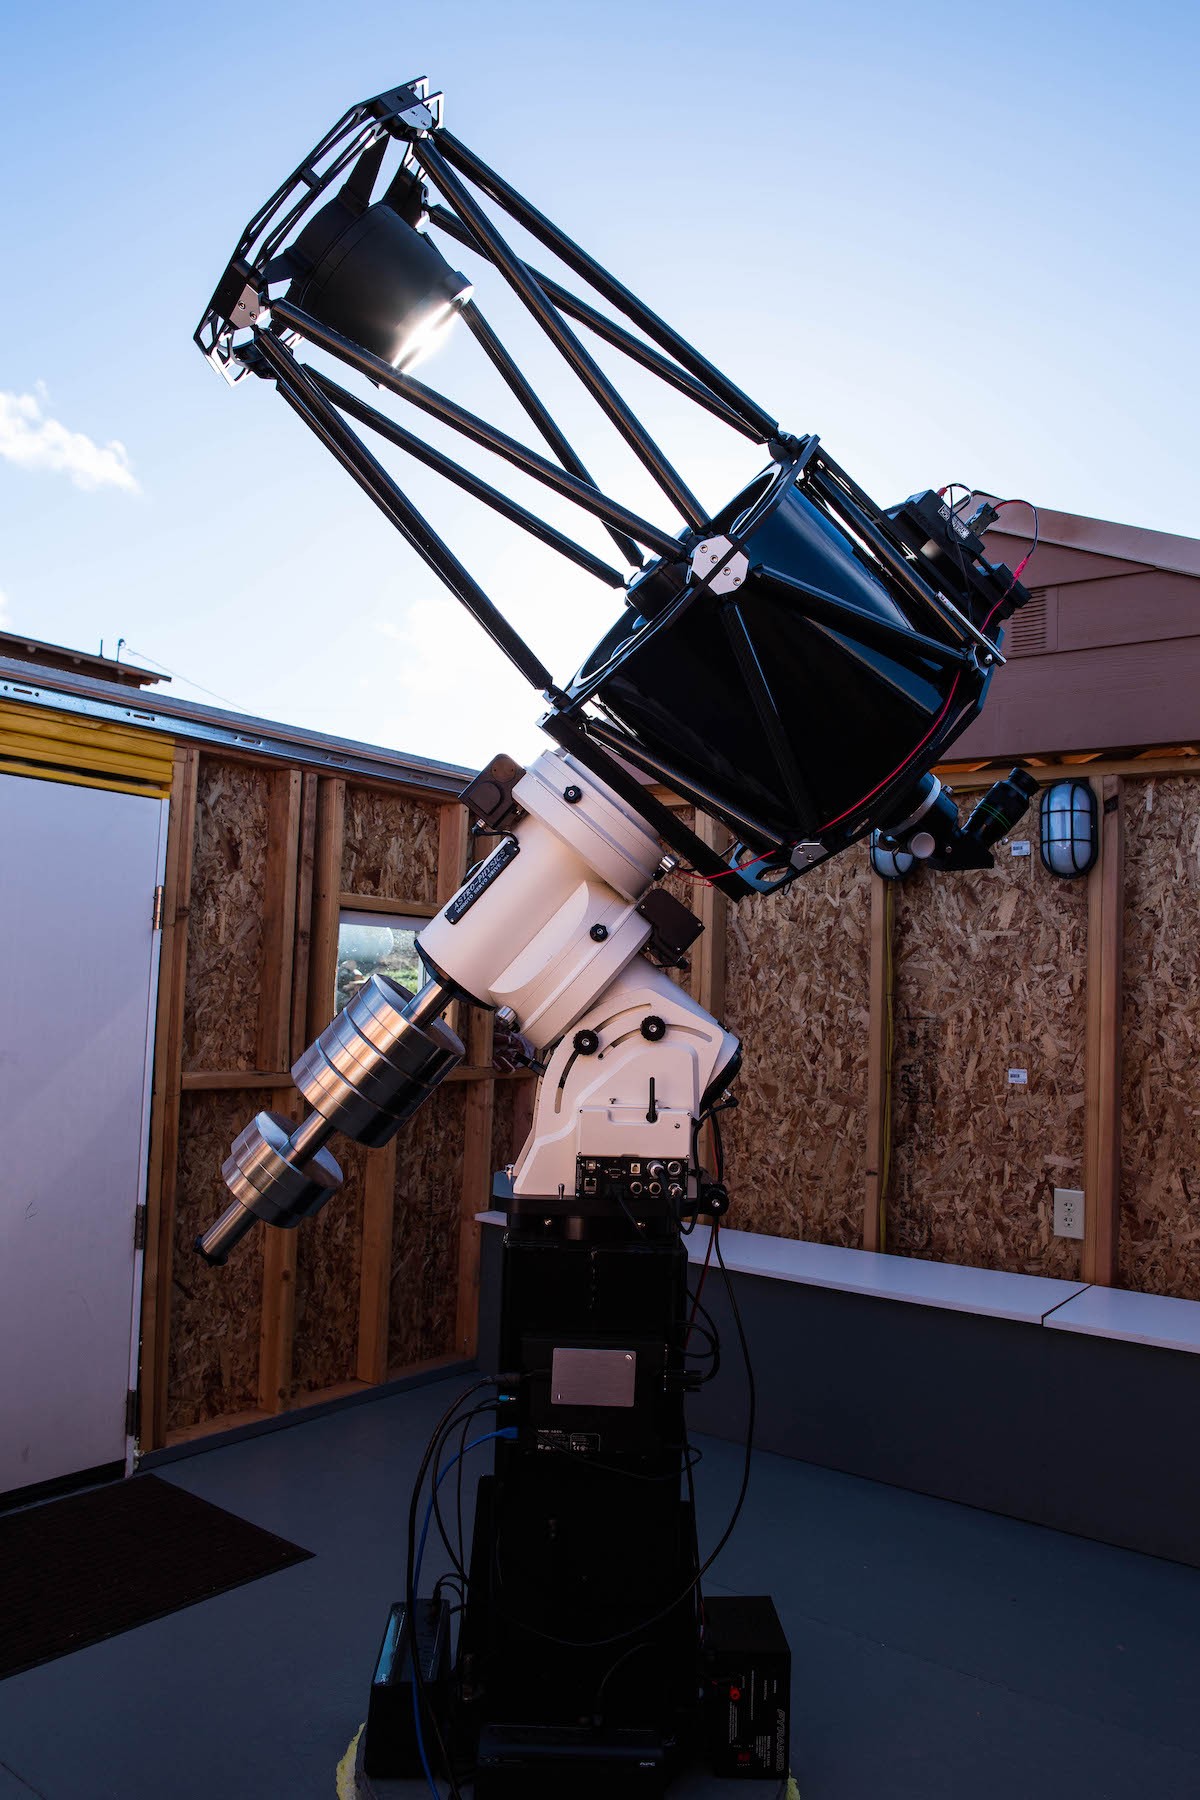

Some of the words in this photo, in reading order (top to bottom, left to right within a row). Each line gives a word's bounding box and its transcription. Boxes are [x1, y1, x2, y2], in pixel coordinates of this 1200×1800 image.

[454, 849, 506, 910] ASTRO-PHYSICS
[473, 879, 488, 895] SERVO
[488, 864, 502, 878] DRIVE
